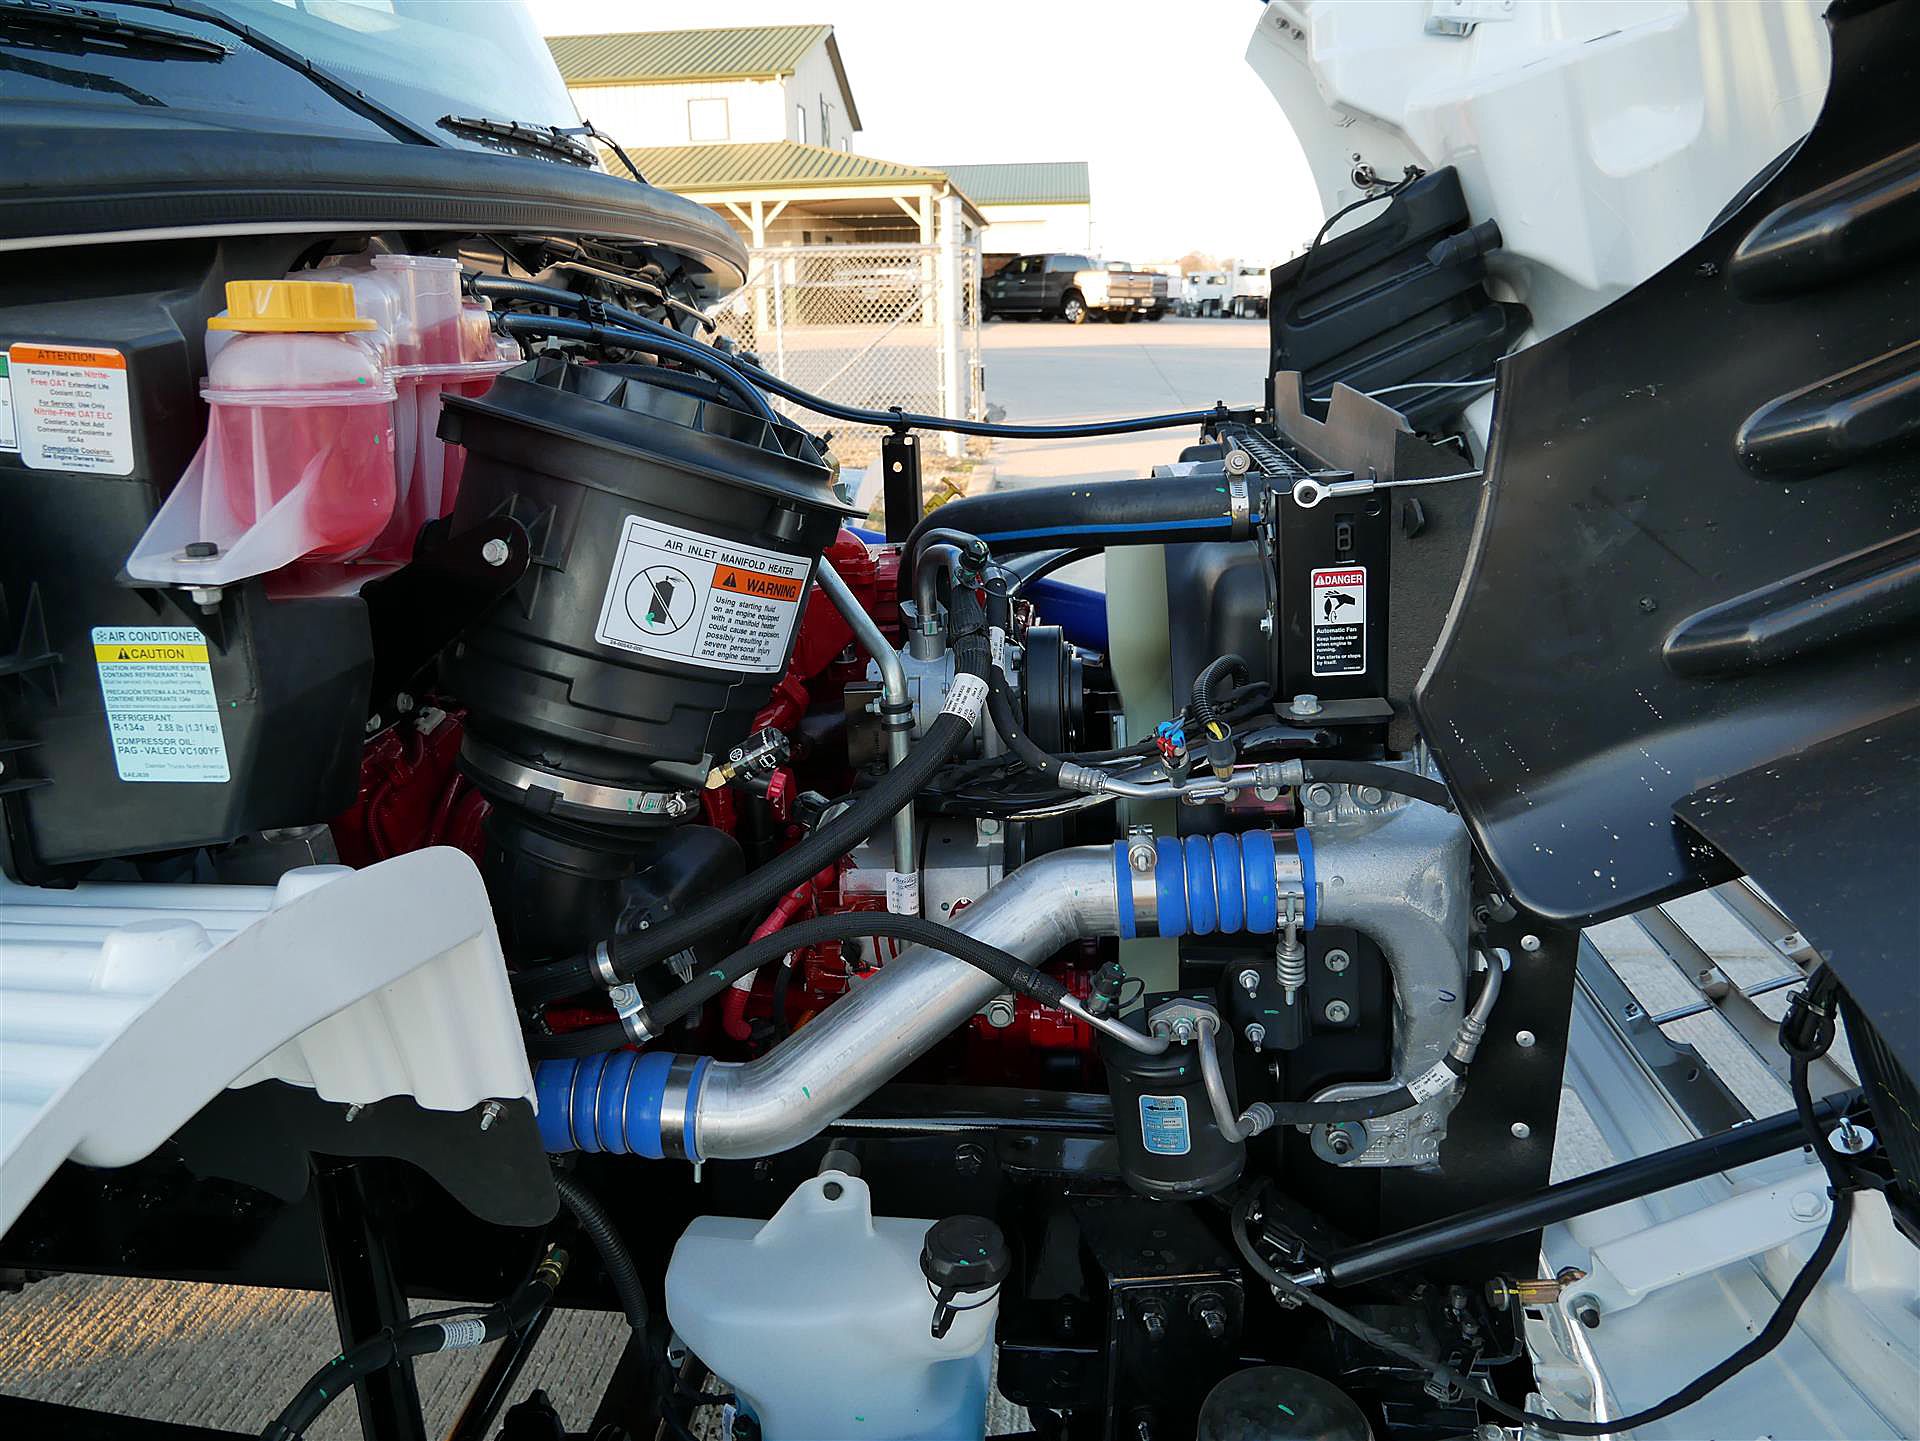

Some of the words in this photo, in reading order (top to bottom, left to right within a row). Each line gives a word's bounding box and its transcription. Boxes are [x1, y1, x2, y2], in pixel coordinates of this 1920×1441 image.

[38, 350, 96, 362] ATTENTION
[27, 369, 50, 377] Factory
[84, 371, 110, 379] Nitrite-
[31, 378, 48, 386] Free
[98, 382, 109, 390] Life
[50, 389, 74, 397] Coolant
[91, 402, 105, 410] Only
[34, 408, 76, 417] Nitrite-Free
[79, 410, 94, 418] OAT
[97, 411, 112, 419] ELC
[42, 445, 79, 453] Compatible
[664, 539, 683, 551] AIR
[687, 544, 717, 560] INLET
[720, 553, 766, 571] MANIFOLD
[768, 563, 794, 576] HEATER
[1325, 575, 1363, 585] DANGER
[747, 578, 797, 598] WARNING
[715, 596, 736, 607] Using
[739, 601, 762, 612] starting
[764, 605, 776, 613] fluid
[735, 610, 756, 619] engine
[757, 614, 780, 622] equipped
[711, 614, 726, 622] with
[734, 618, 760, 629] manifold
[761, 622, 776, 630] heater
[708, 623, 728, 632] could
[730, 627, 747, 635] cause
[108, 632, 126, 641] AIR
[128, 632, 201, 641] CONDITIONER
[706, 631, 736, 643] possibly
[737, 636, 762, 647] resulting
[131, 649, 185, 659] CAUTION
[704, 640, 727, 649] severe
[728, 644, 756, 653] personal
[758, 647, 770, 657] injury
[702, 649, 716, 657] and
[717, 651, 738, 660] engine
[113, 723, 145, 731] R-134a
[176, 723, 184, 731] lb
[185, 723, 204, 733] (1.31
[205, 723, 218, 734] kg)
[116, 737, 176, 745] COMPRESSOR
[118, 747, 138, 755] PAG
[144, 747, 177, 755] VALEO
[179, 747, 220, 755] VC100YF
